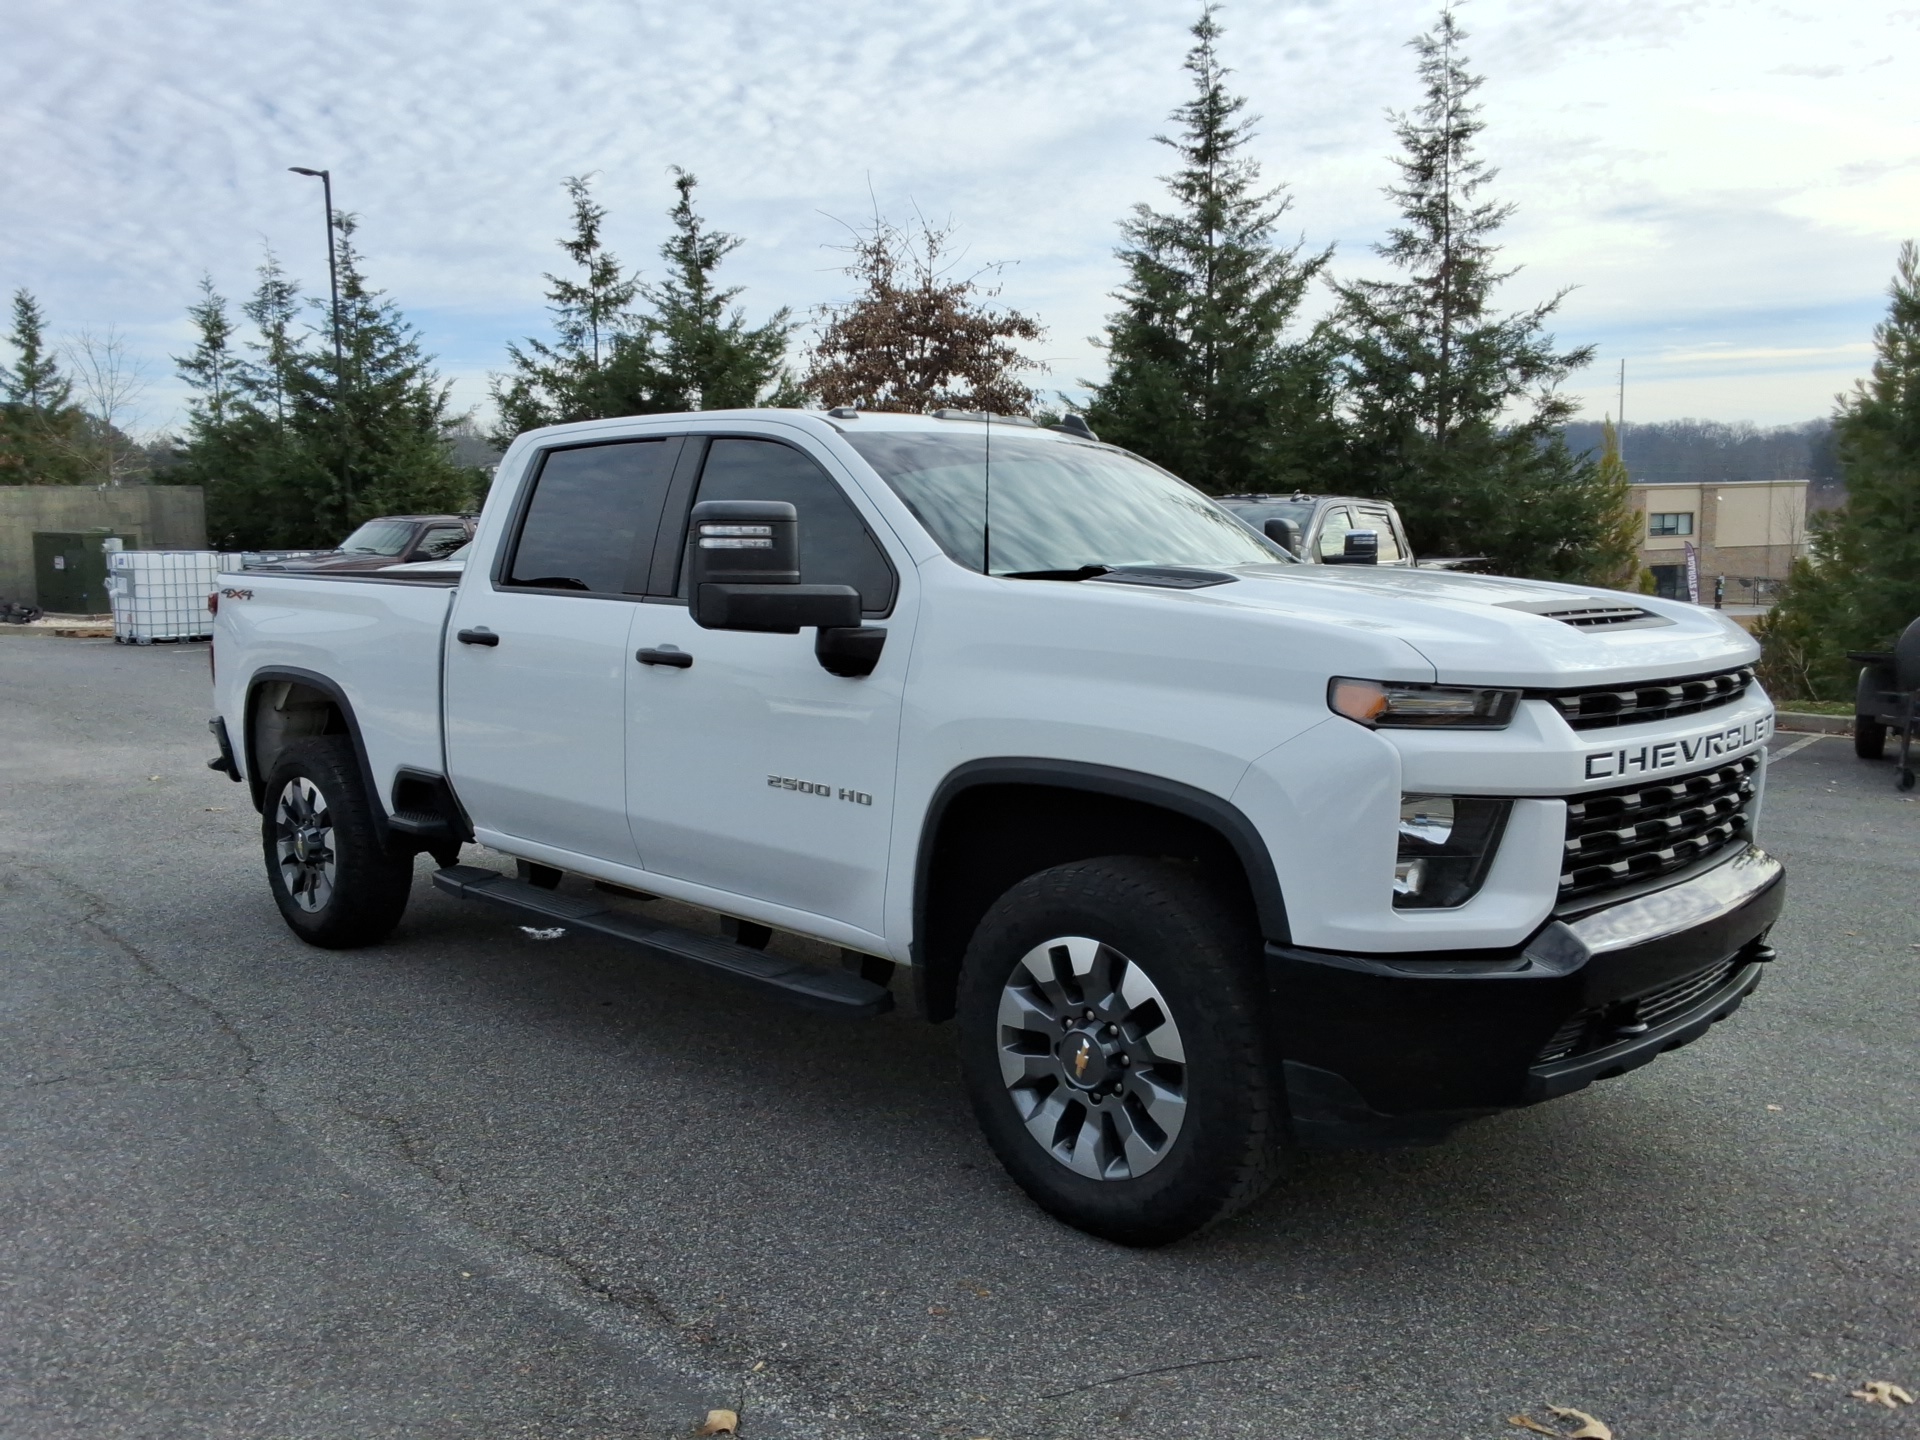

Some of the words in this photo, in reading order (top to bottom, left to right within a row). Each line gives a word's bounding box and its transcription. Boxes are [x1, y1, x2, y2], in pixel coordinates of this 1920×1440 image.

[1585, 713, 1773, 780] CHEVROLET
[767, 774, 831, 797] 2500
[838, 787, 872, 806] HD
